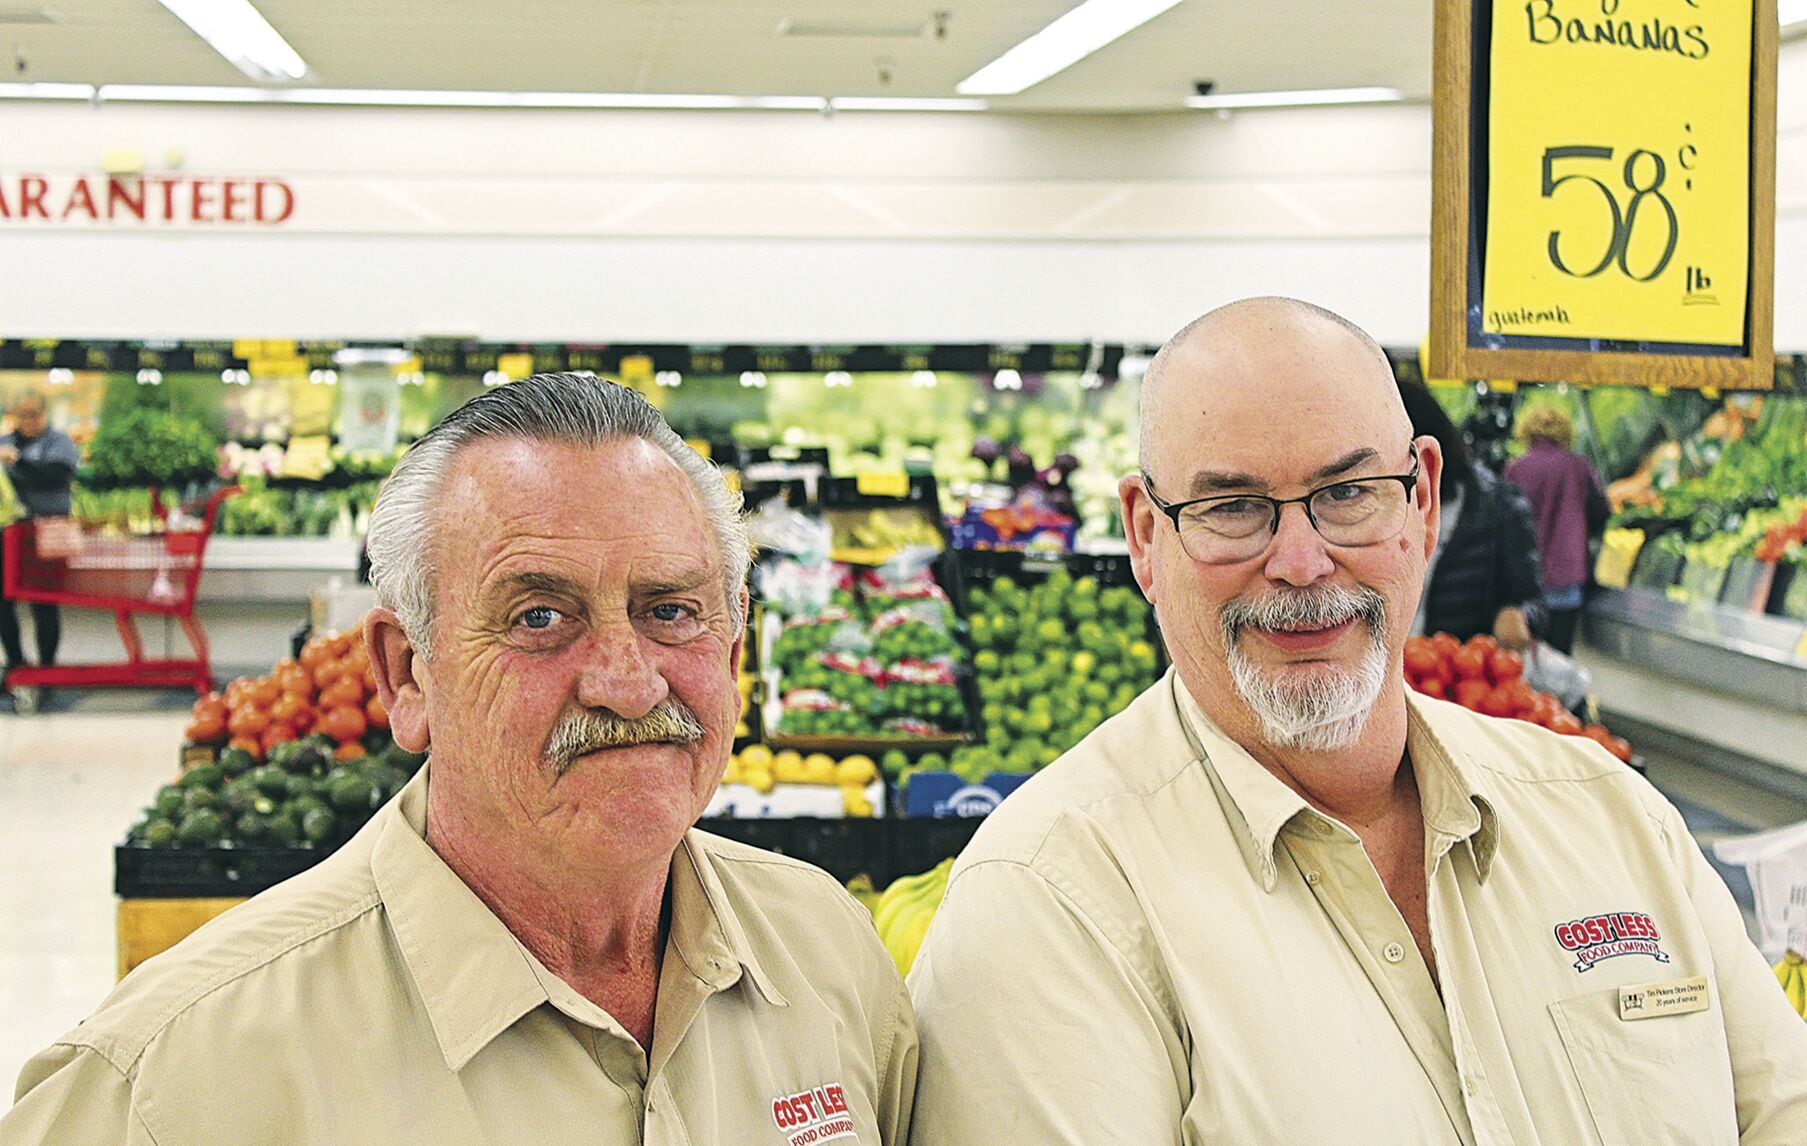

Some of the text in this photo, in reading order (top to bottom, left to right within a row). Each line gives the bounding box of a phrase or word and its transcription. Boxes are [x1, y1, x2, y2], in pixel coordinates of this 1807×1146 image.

[1541, 146, 1679, 282] 58
[1686, 266, 1712, 293] lb
[1557, 914, 1659, 948] COST LESS
[1580, 940, 1659, 963] FOOD COMPANY
[1663, 997, 1676, 1007] years
[1681, 995, 1698, 1003] service
[1674, 984, 1687, 994] Store
[1687, 983, 1705, 992] Director
[773, 1092, 818, 1128] COST
[791, 1129, 818, 1146] FOOD
